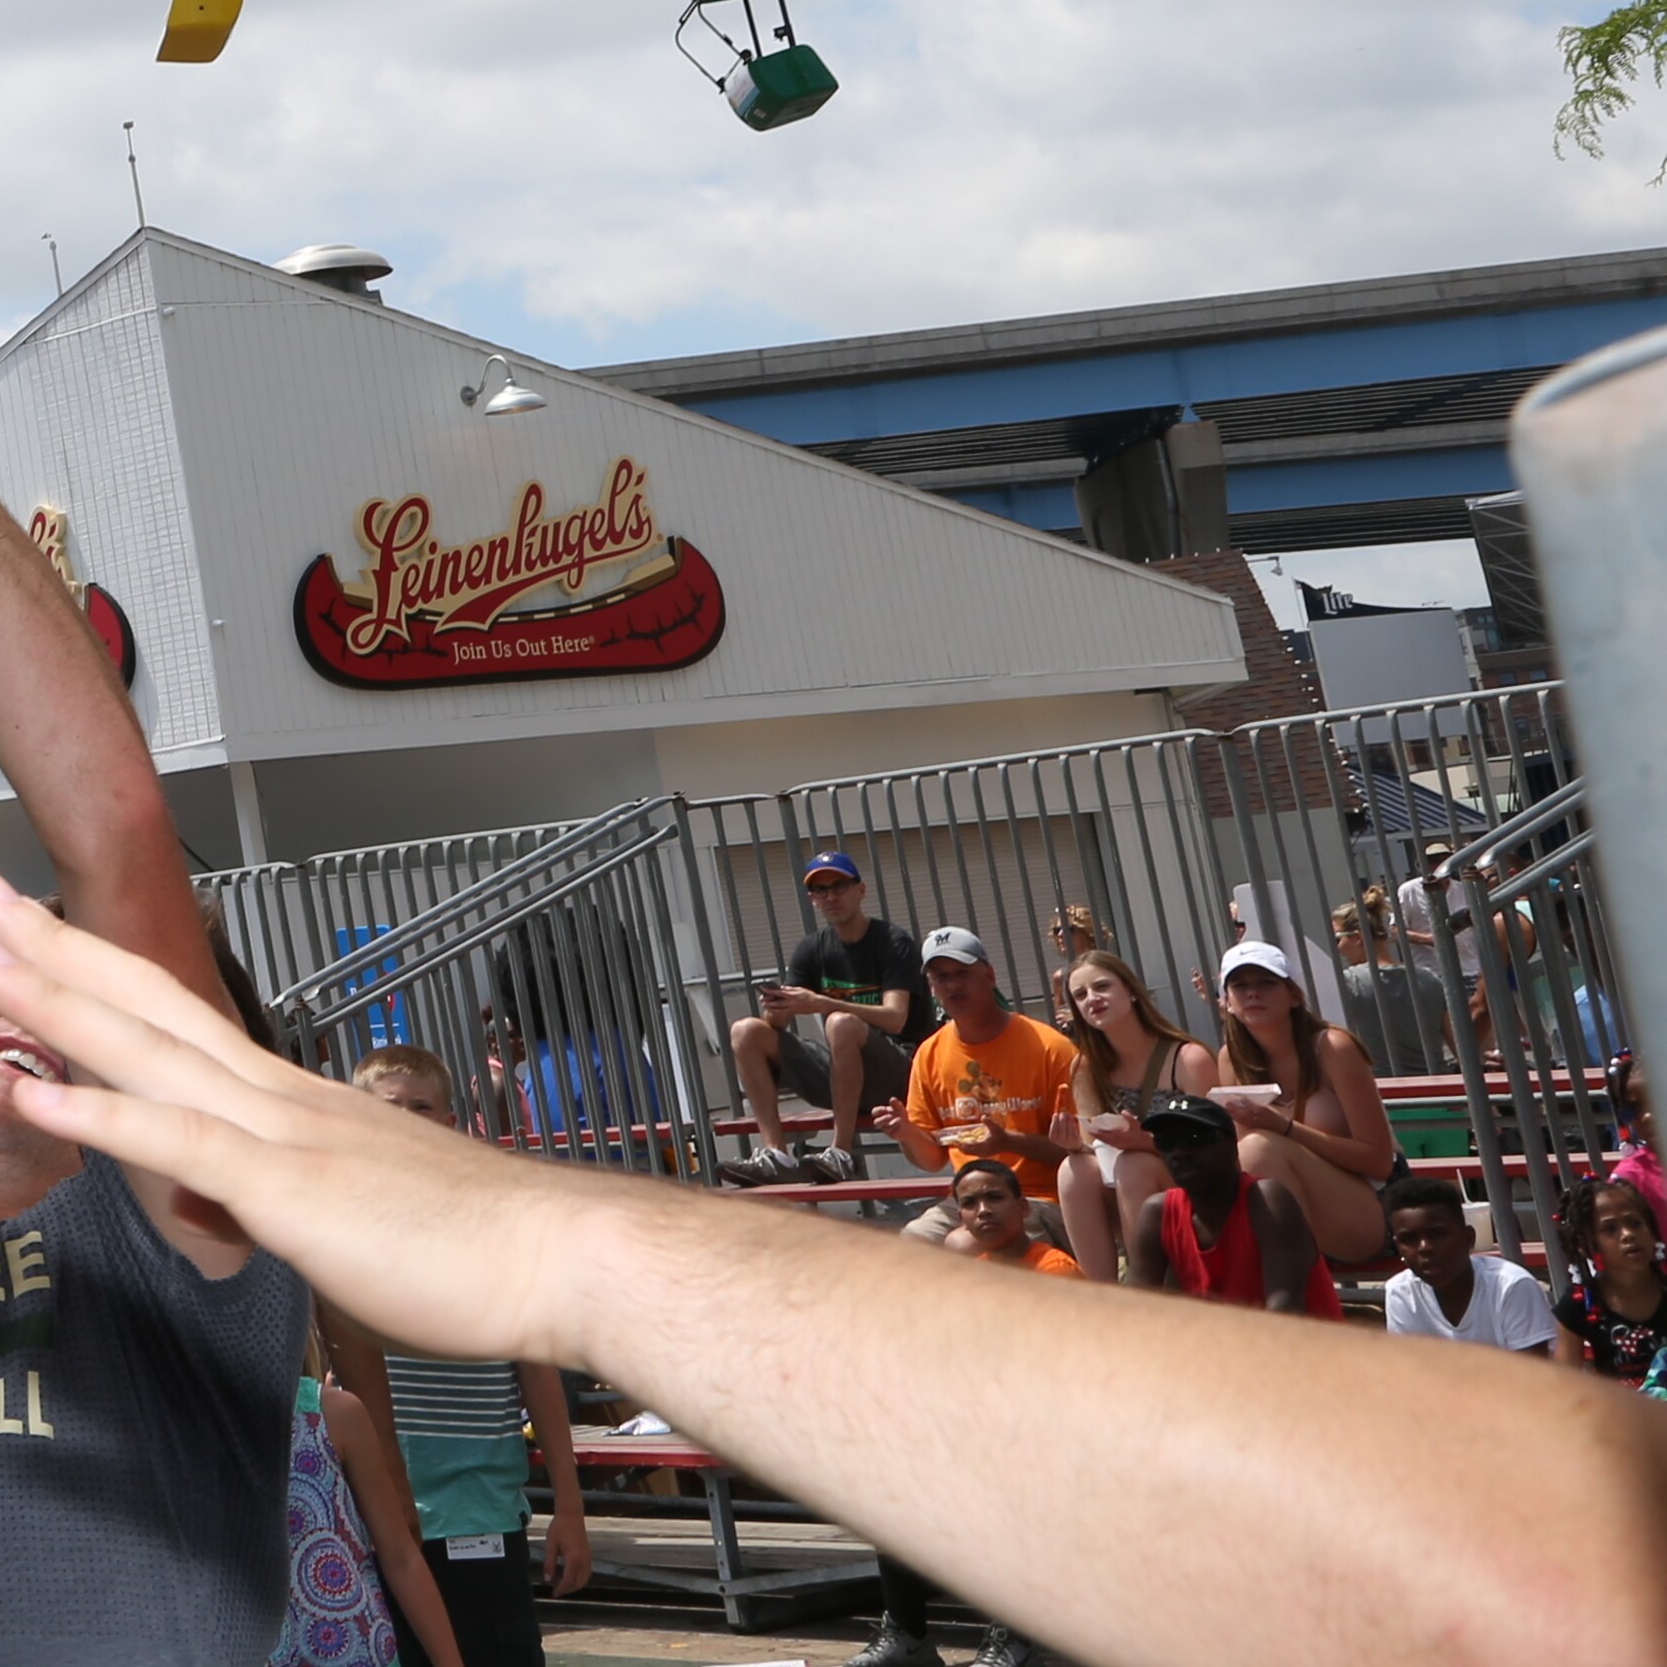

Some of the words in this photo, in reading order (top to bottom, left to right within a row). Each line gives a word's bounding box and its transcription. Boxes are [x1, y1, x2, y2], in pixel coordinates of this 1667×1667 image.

[346, 456, 654, 654] Leinenkugel's
[452, 642, 487, 665] Join
[490, 640, 512, 658] Us
[515, 638, 548, 657] Out
